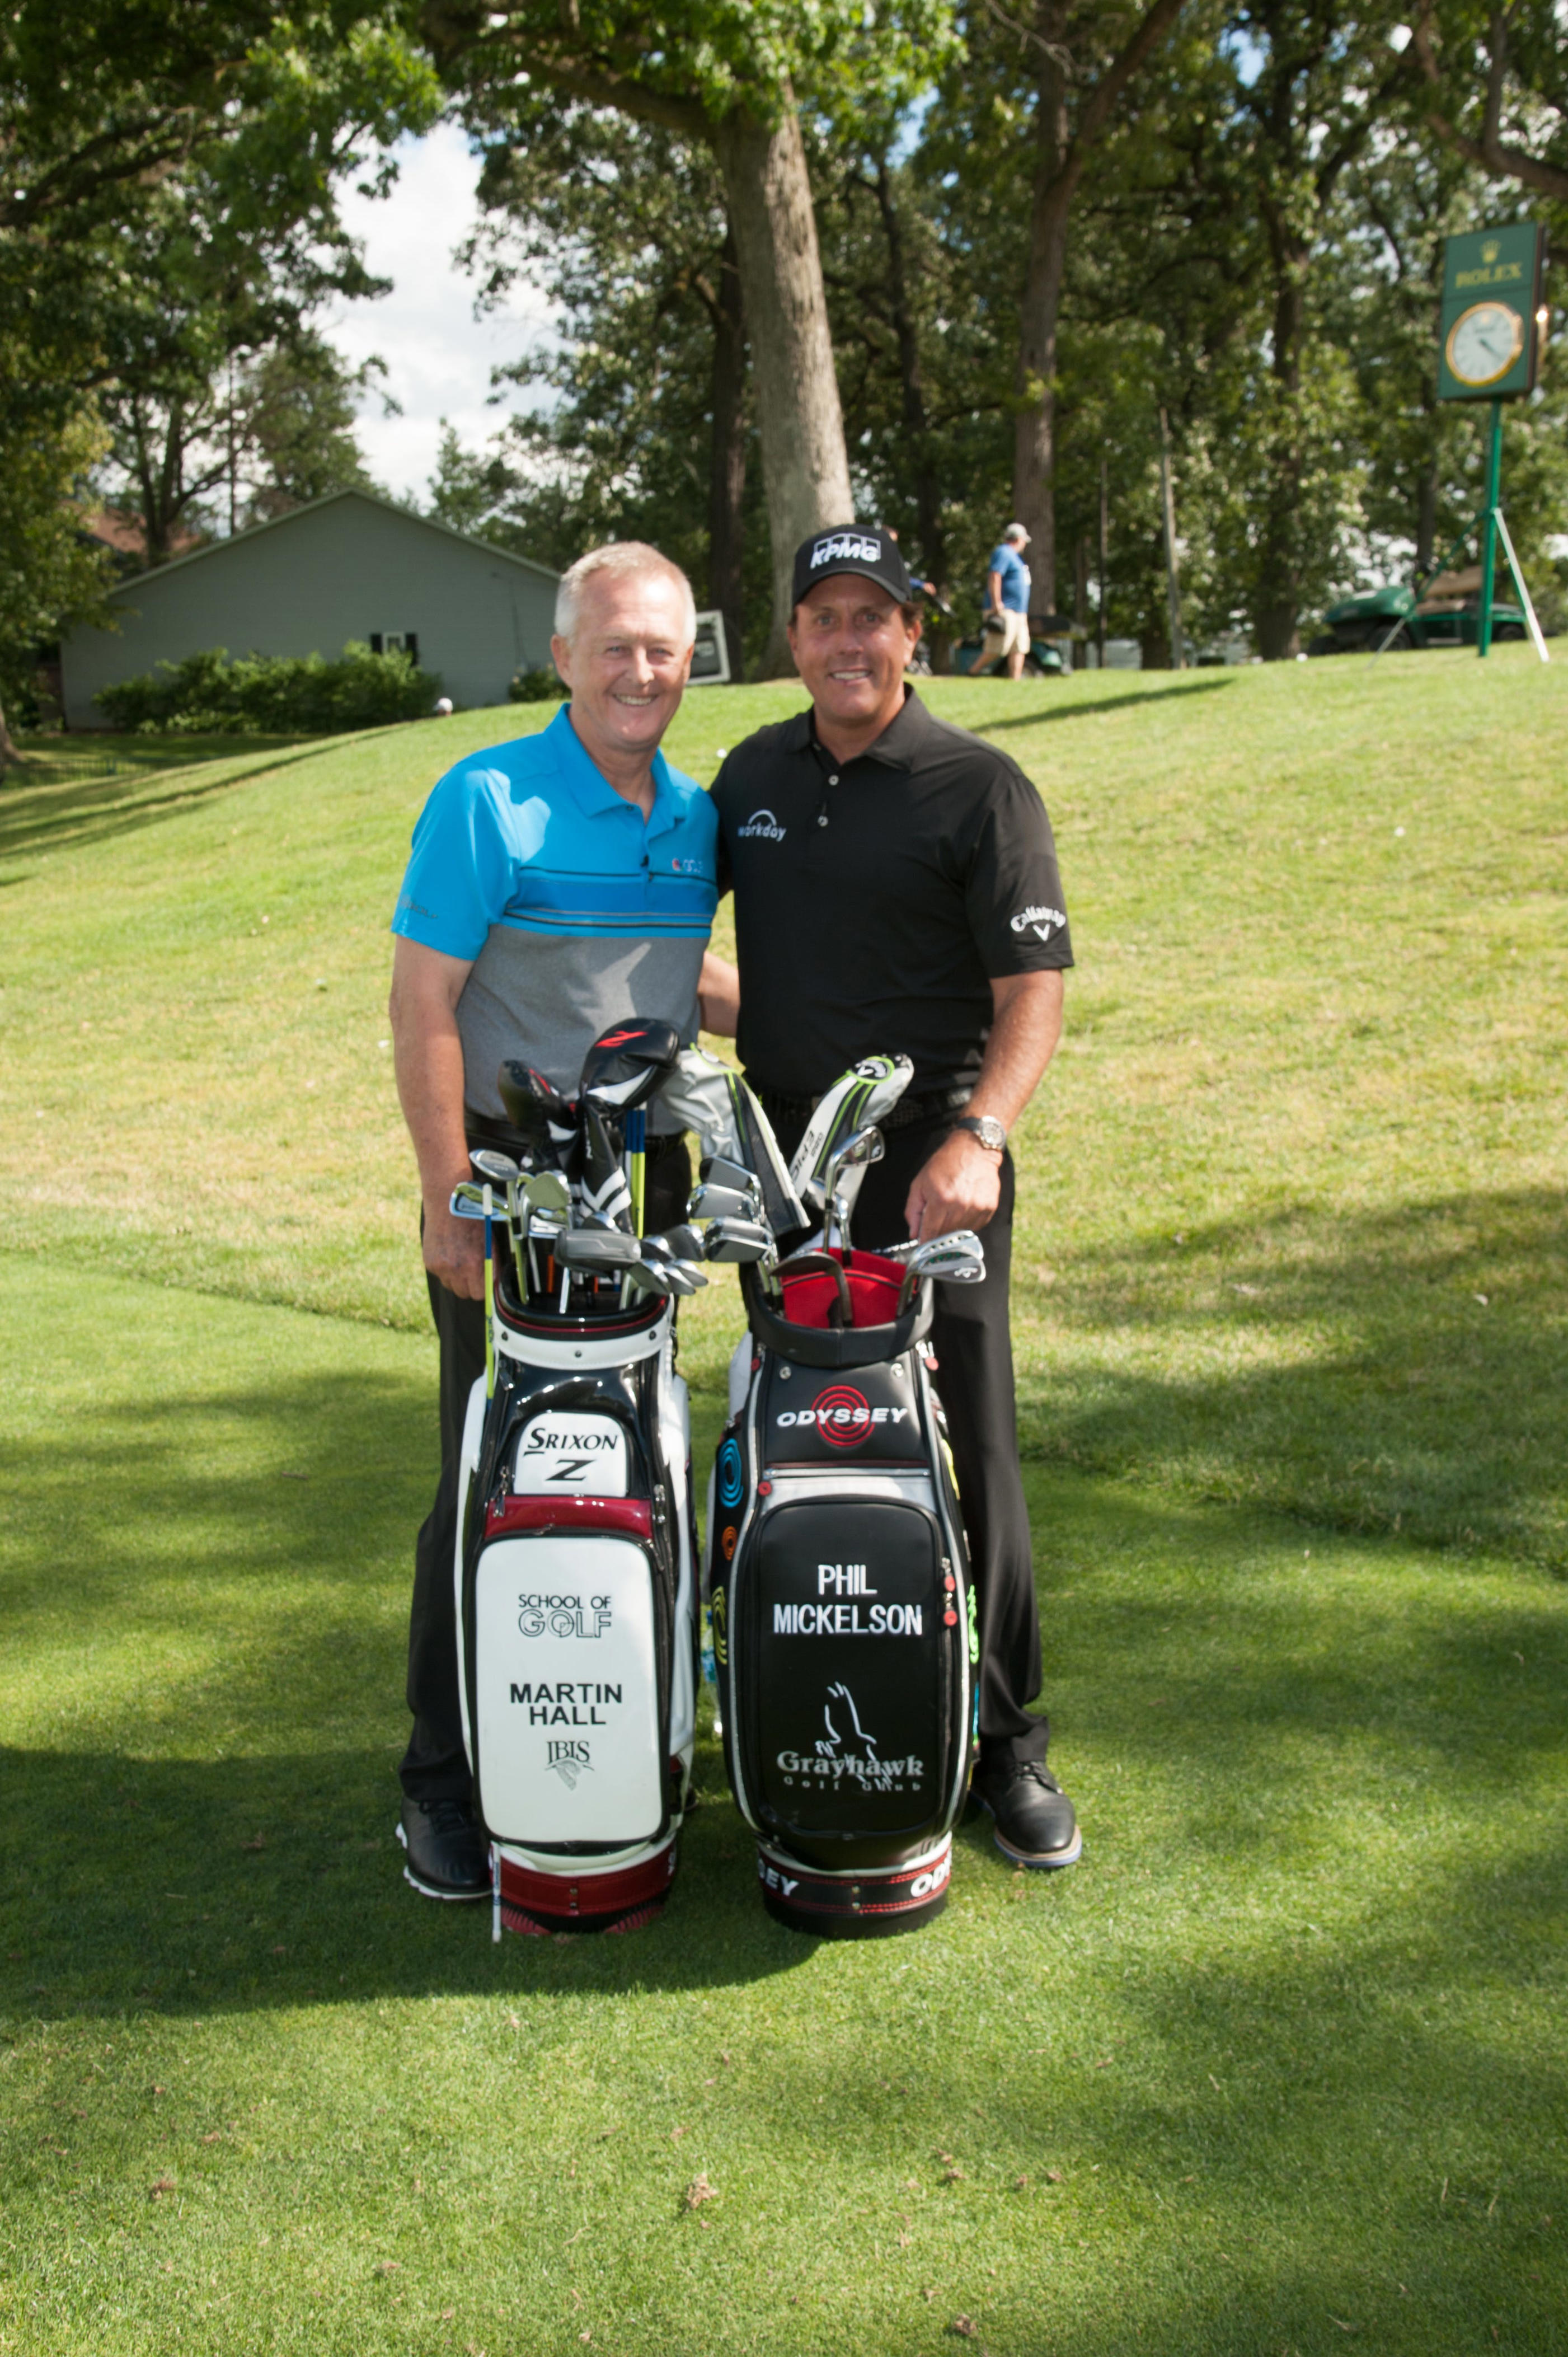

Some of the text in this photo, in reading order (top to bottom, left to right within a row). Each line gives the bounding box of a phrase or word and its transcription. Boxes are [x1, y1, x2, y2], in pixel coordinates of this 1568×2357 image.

[1456, 261, 1523, 288] ROLEX
[810, 540, 880, 569] KPMG
[738, 822, 786, 842] workday
[776, 1407, 909, 1428] ODYSSEY
[544, 1459, 597, 1481] Z
[817, 1564, 878, 1596] PHIL
[518, 1594, 612, 1610] SCHOOL OF
[518, 1609, 612, 1638] GOLF
[772, 1603, 923, 1636] MICKELSON
[510, 1683, 623, 1704] MARTIN
[529, 1705, 607, 1726] HALL
[546, 1740, 590, 1765] IBIS
[776, 1750, 924, 1779] Grayhawk
